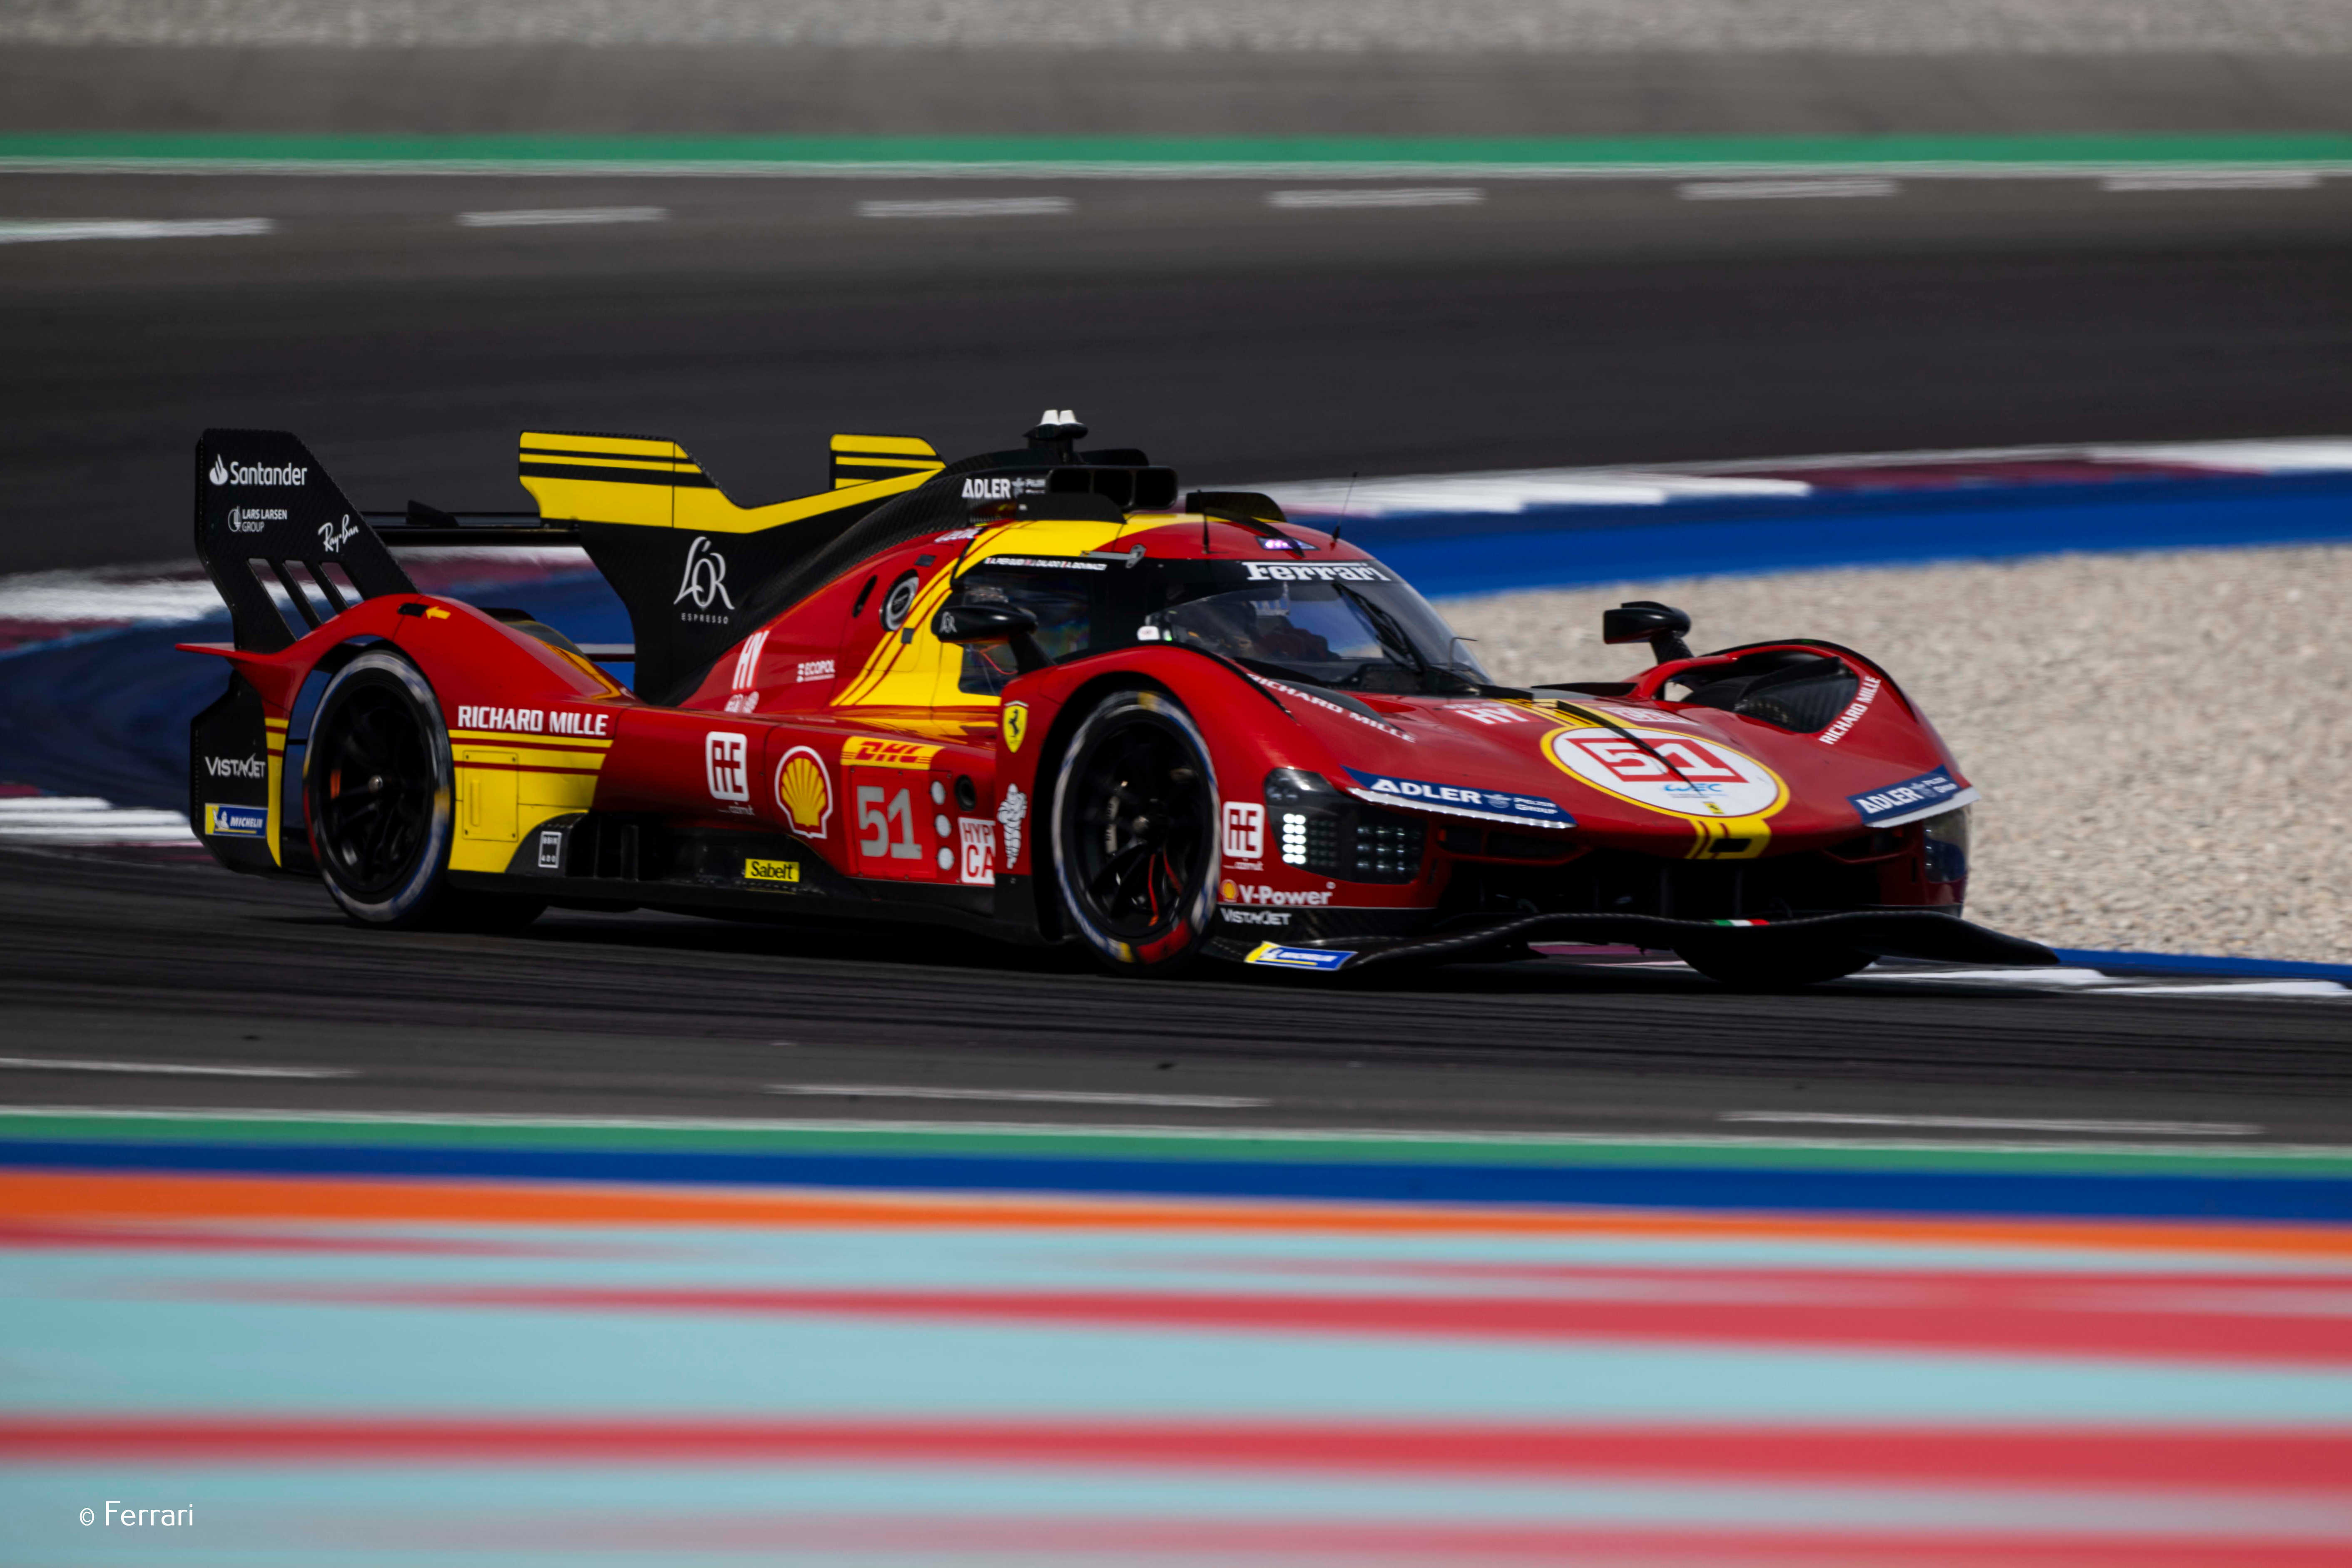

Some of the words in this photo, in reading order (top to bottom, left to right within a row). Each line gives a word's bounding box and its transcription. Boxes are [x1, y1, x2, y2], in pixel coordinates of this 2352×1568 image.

[229, 461, 308, 486] Santander
[961, 478, 1011, 499] ADLER
[242, 509, 260, 520] LARS
[261, 509, 288, 520] LARSEN
[241, 521, 265, 533] GROUP
[1241, 562, 1391, 582] Ferrari
[681, 612, 729, 624] ESPRESSO
[1246, 673, 1344, 714] RICHARD
[1349, 710, 1416, 744] MILLE
[1454, 708, 1531, 724] HY
[1818, 702, 1868, 745] RICHARD
[1856, 675, 1882, 704] MILLE
[458, 705, 544, 732] RICHARD
[549, 711, 610, 736] MILLE
[854, 741, 925, 763] DHL
[1580, 742, 1737, 778] 51
[1371, 778, 1483, 804] ADLER
[1663, 783, 1722, 792] WEC
[1856, 786, 1925, 814] ADLER
[230, 815, 263, 829] MICHELIN
[856, 785, 923, 859] 51
[961, 822, 994, 844] HYP
[751, 861, 794, 880] Sabelt
[1238, 884, 1333, 906] V-Power
